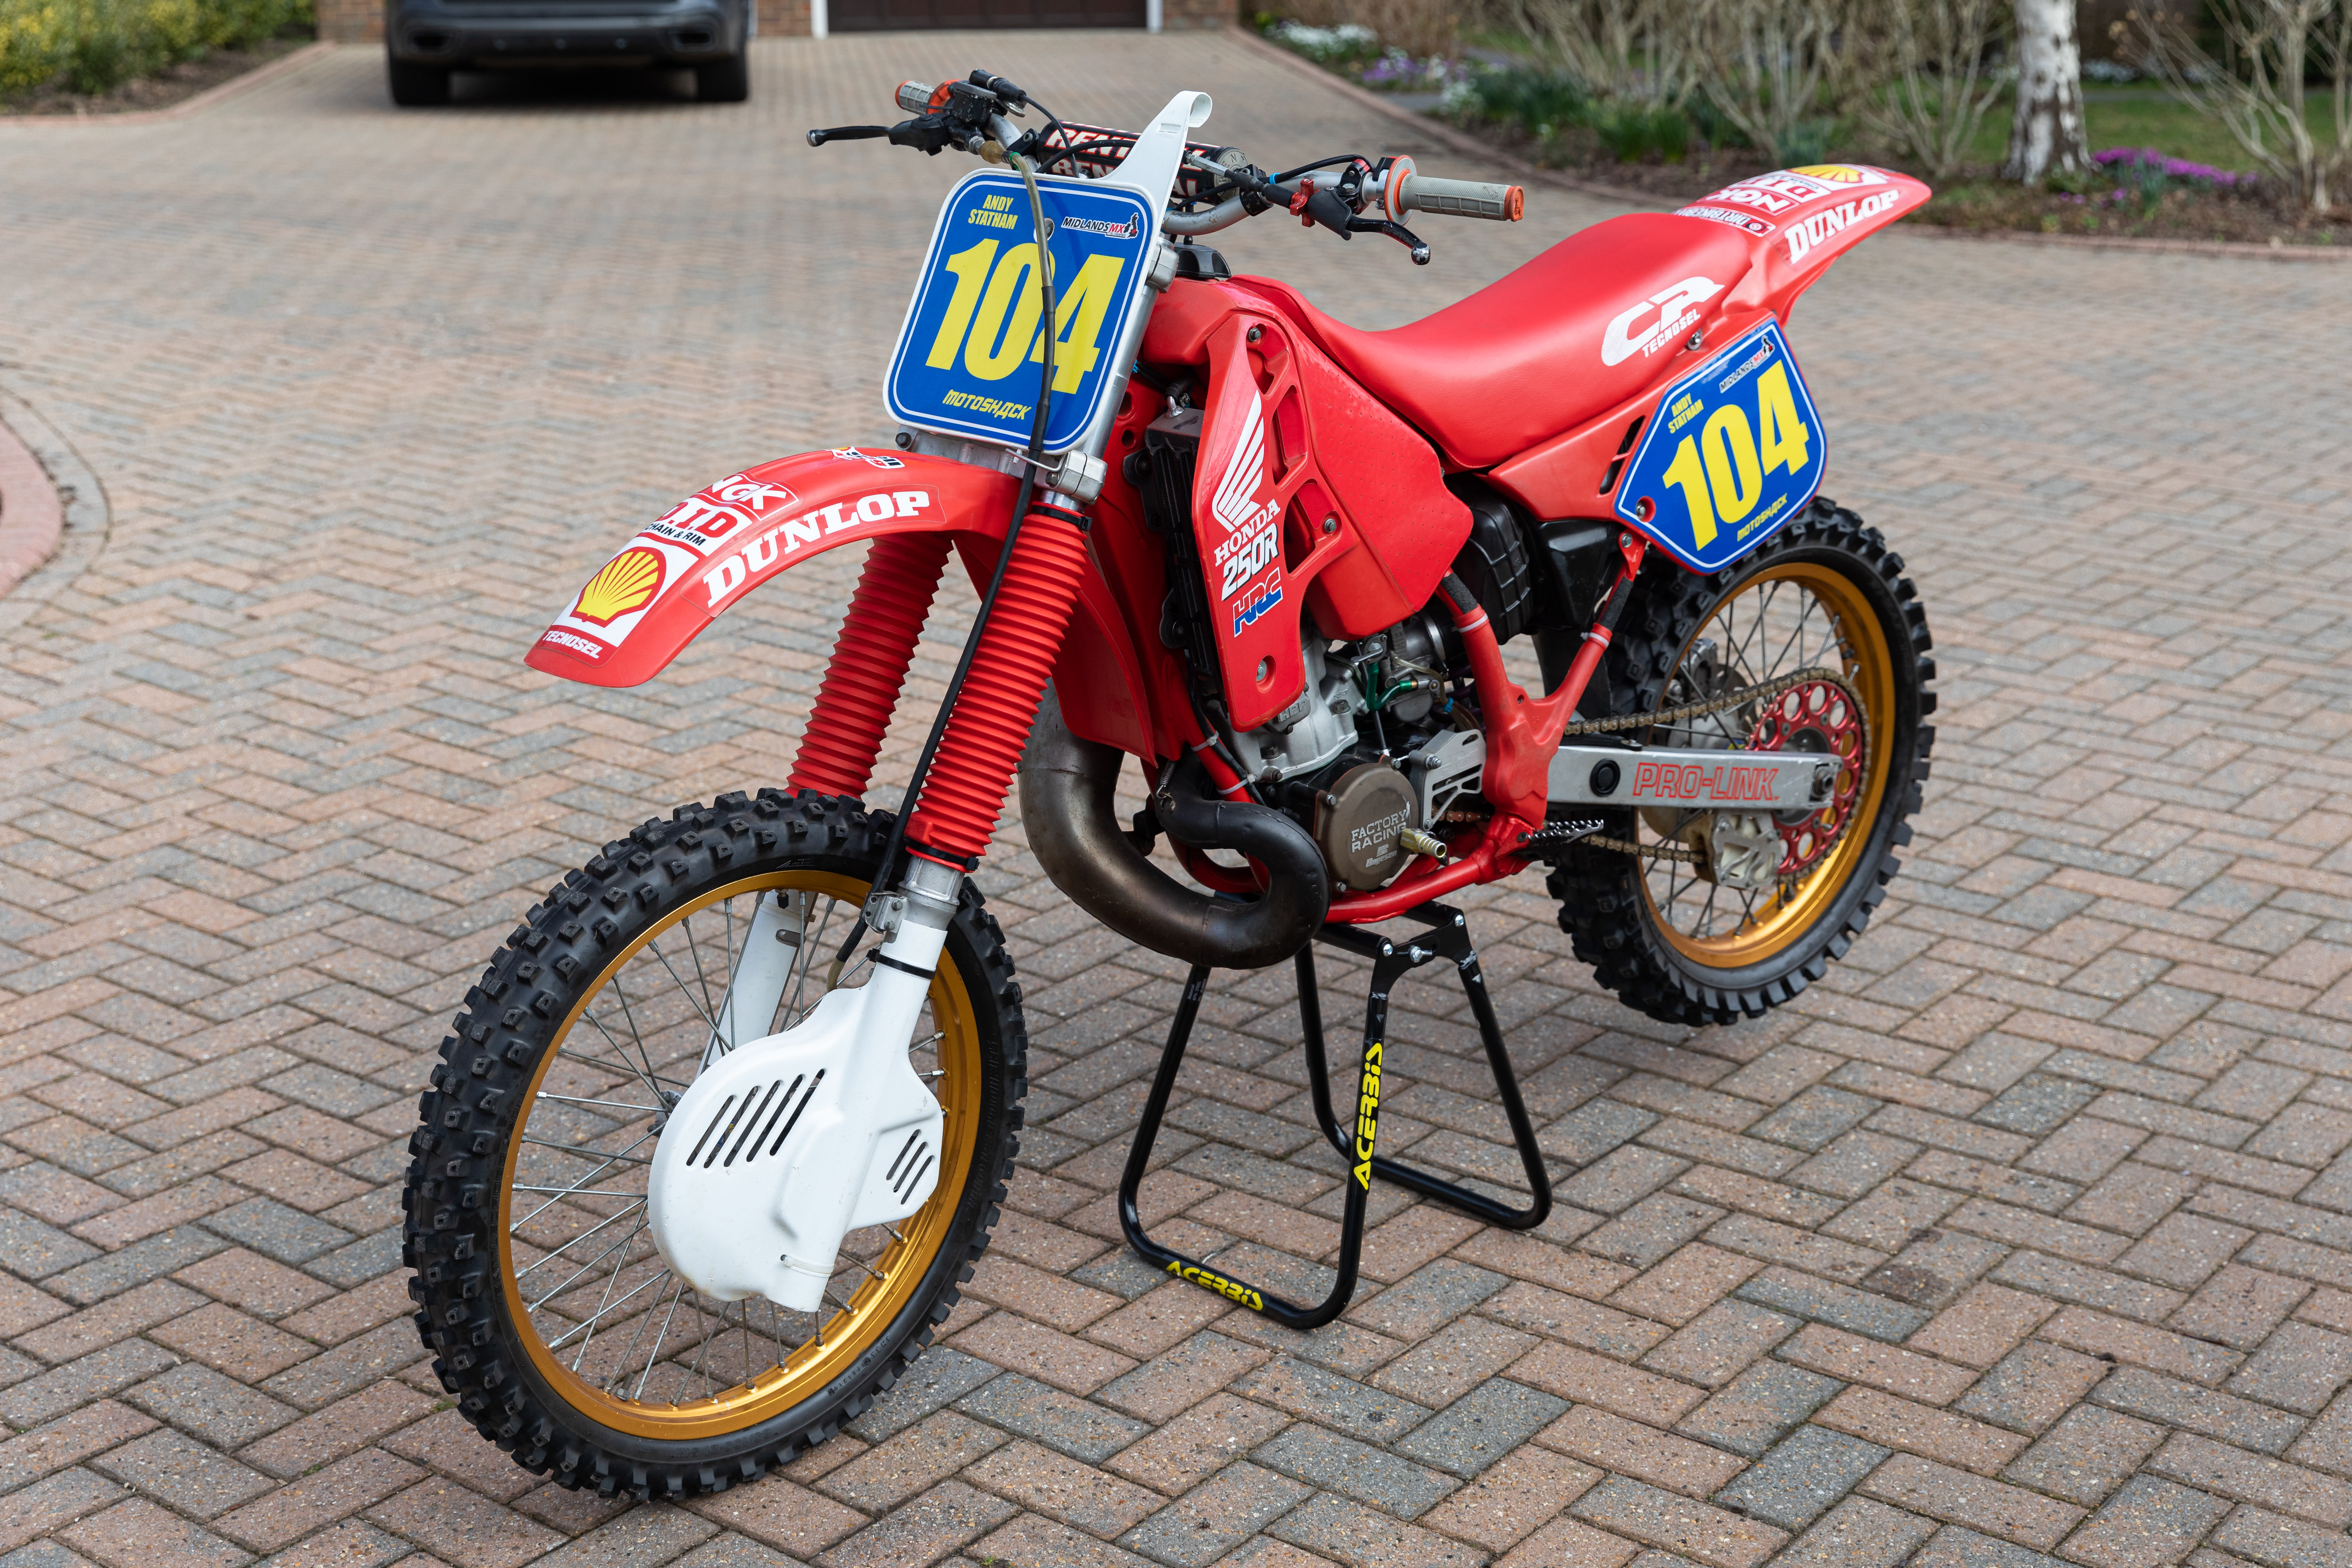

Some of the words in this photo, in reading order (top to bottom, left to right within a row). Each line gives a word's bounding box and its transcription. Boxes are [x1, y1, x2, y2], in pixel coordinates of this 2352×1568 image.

[968, 209, 1018, 230] STATHAM
[982, 194, 1014, 212] ANDY
[1706, 188, 1791, 212] NGK
[1785, 189, 1900, 265] DUNLOP
[925, 238, 1125, 395] 104
[1601, 276, 1725, 367] CR
[1642, 308, 1701, 358] TECNOSEL
[1668, 399, 1704, 434] STATHAM
[1671, 392, 1692, 418] ANDY
[1662, 359, 1810, 551] 104
[712, 475, 787, 510] NGK
[645, 523, 676, 536] CHAIN
[682, 532, 707, 546] RIM
[703, 491, 930, 608] DUNLOP
[1214, 498, 1281, 567] HONDA
[1221, 523, 1280, 602] 250R
[1233, 566, 1283, 638] HRC
[542, 630, 603, 659] TECNOSEL
[1632, 762, 1779, 801] PRO-LINK
[1351, 809, 1407, 842] FACTORY
[1352, 822, 1407, 853] RACING
[1365, 850, 1397, 868] Boyesen
[1354, 1042, 1383, 1190] ACERBIS
[1165, 1260, 1263, 1311] ACERBIS
